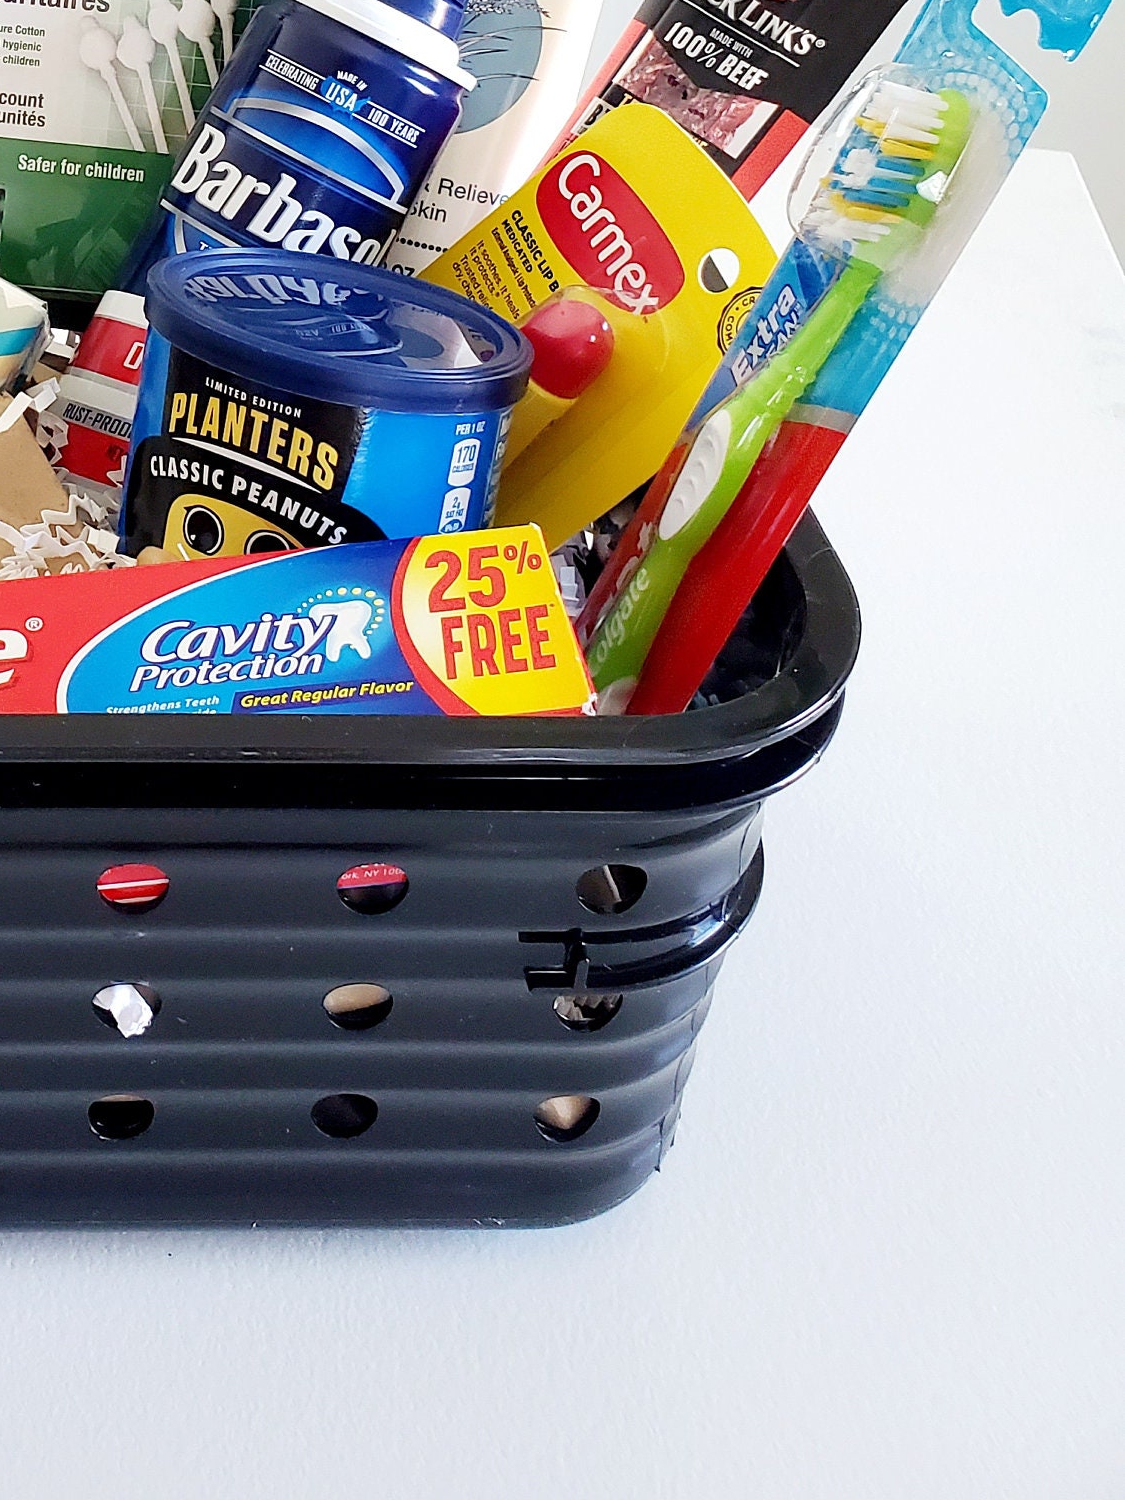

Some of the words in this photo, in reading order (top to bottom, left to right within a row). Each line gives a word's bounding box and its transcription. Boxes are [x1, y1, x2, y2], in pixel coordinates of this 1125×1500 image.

[2, 39, 42, 52] hygienic
[15, 25, 46, 37] Cotton
[709, 27, 733, 49] MADE
[733, 39, 754, 58] WITH
[740, 0, 818, 56] LINK'S
[2, 54, 41, 67] children
[265, 54, 320, 91] CELEBRATING
[663, 21, 724, 69] 100%
[715, 54, 769, 91] BEEF
[325, 82, 358, 112] USA
[336, 70, 359, 85] MADE
[356, 79, 369, 92] IN
[367, 107, 391, 127] 100
[389, 118, 420, 143] YEARS
[17, 153, 57, 174] Safer
[60, 157, 82, 176] for
[84, 161, 145, 183] children
[501, 218, 533, 274] MEDICATED
[511, 209, 543, 261] CLASSIC
[537, 258, 554, 280] LIP
[557, 152, 661, 317] Carmex
[460, 254, 482, 290] Trusted
[504, 292, 520, 320] heals
[730, 284, 796, 387] Extra
[205, 376, 248, 401] LIMITED
[252, 395, 302, 419] EDITION
[63, 402, 133, 438] RUST-PROO
[455, 423, 471, 436] PER
[168, 392, 339, 491] PLANTERS
[457, 444, 477, 464] 170
[150, 455, 225, 491] CLASSIC
[231, 475, 348, 545] PEANUTS
[424, 539, 543, 613] 25%
[139, 611, 337, 665] Cavity
[441, 603, 556, 681] FREE
[129, 652, 324, 693] Protection
[185, 695, 220, 708] Teeth
[240, 691, 289, 708] Great
[291, 684, 357, 705] Regular
[358, 680, 415, 697] Flavor
